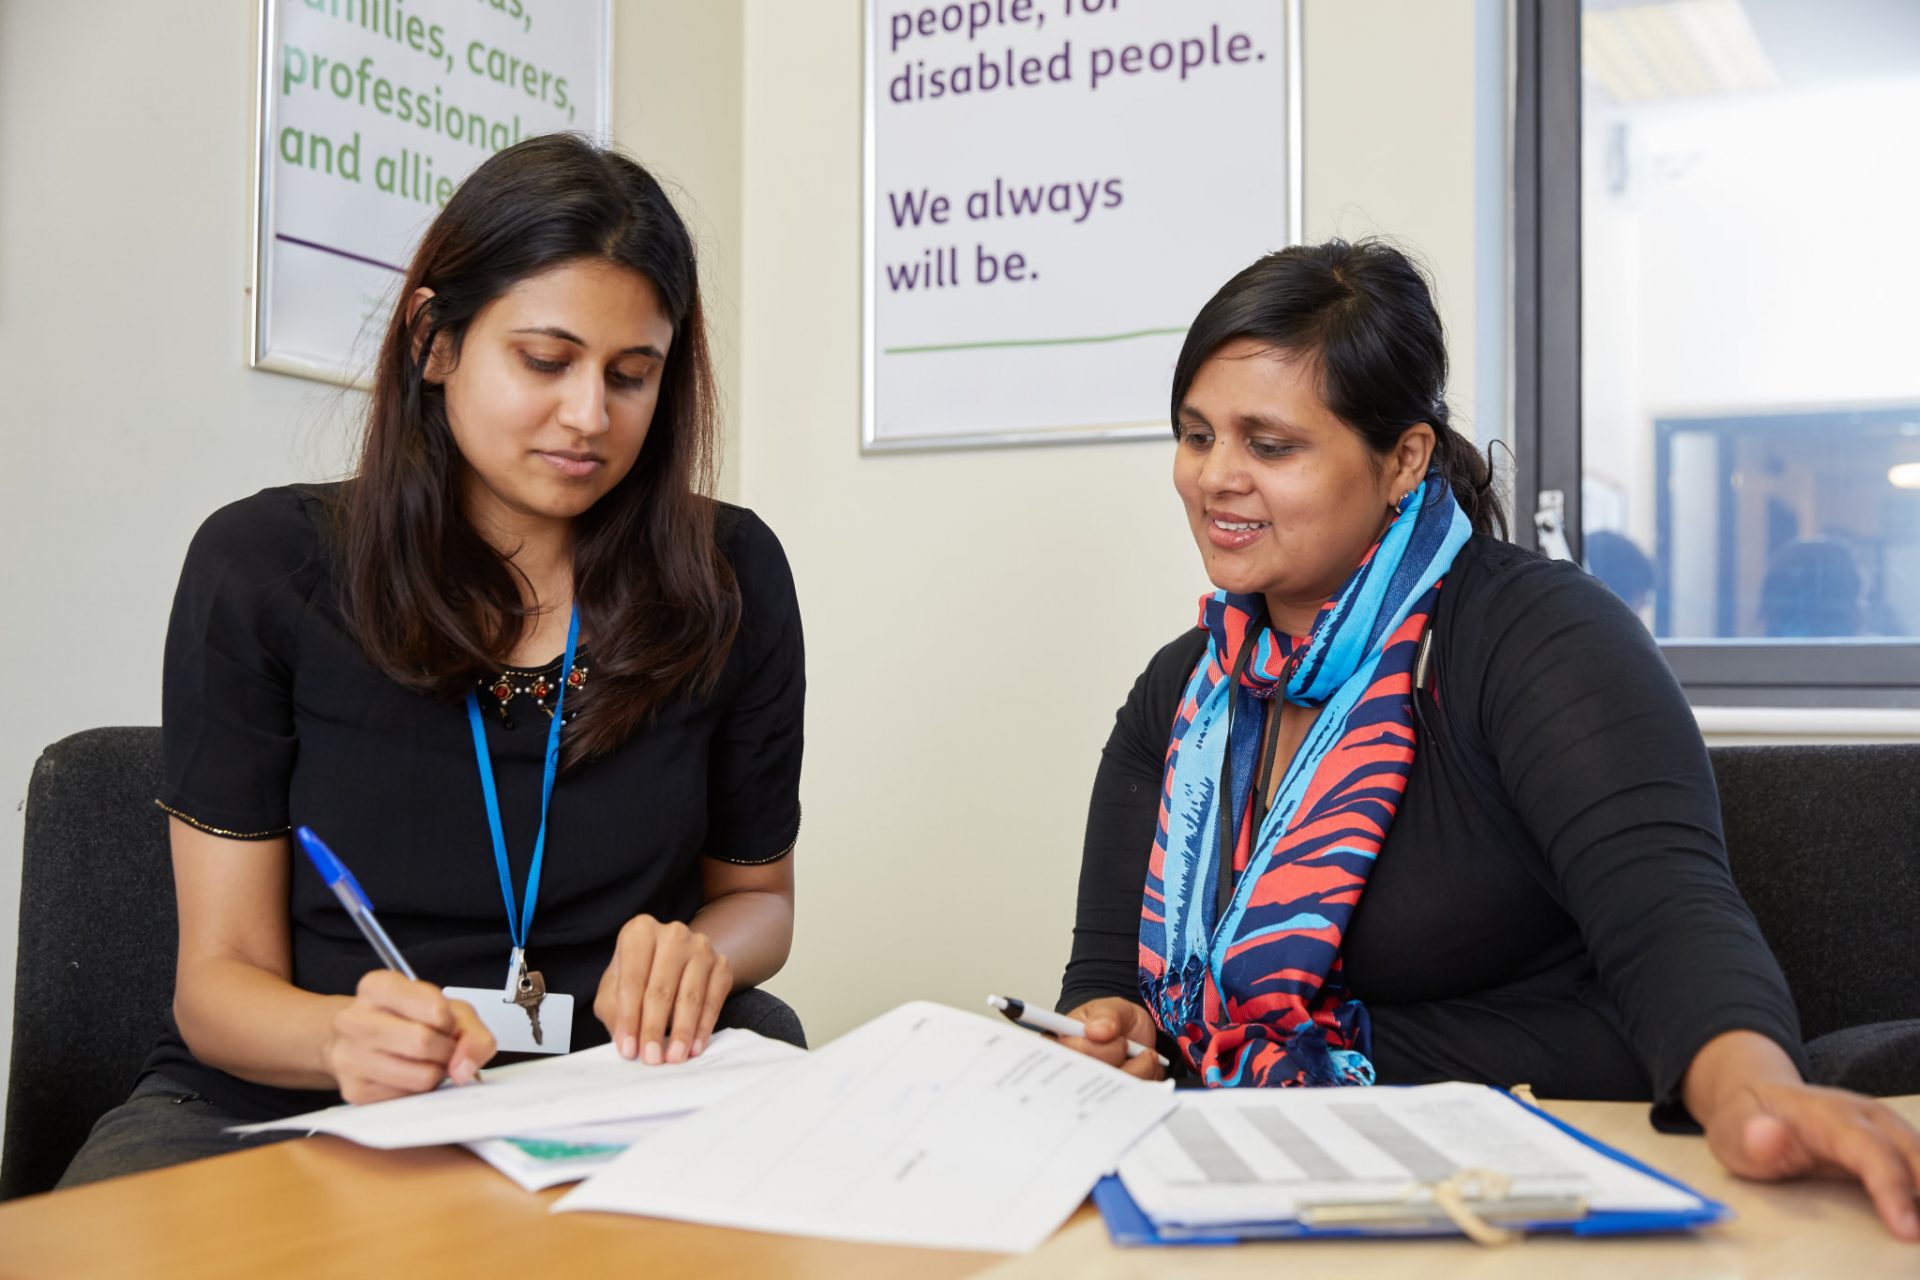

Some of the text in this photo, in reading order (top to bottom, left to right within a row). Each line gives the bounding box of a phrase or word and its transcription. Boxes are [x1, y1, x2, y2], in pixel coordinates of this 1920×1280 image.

[891, 0, 1045, 52] people,
[467, 40, 576, 123] carers,
[889, 24, 1265, 104] disabled people.
[283, 43, 536, 154] professional
[280, 126, 361, 183] and
[375, 148, 454, 209] allie
[888, 178, 1123, 229] We always
[886, 244, 1038, 292] will be.
